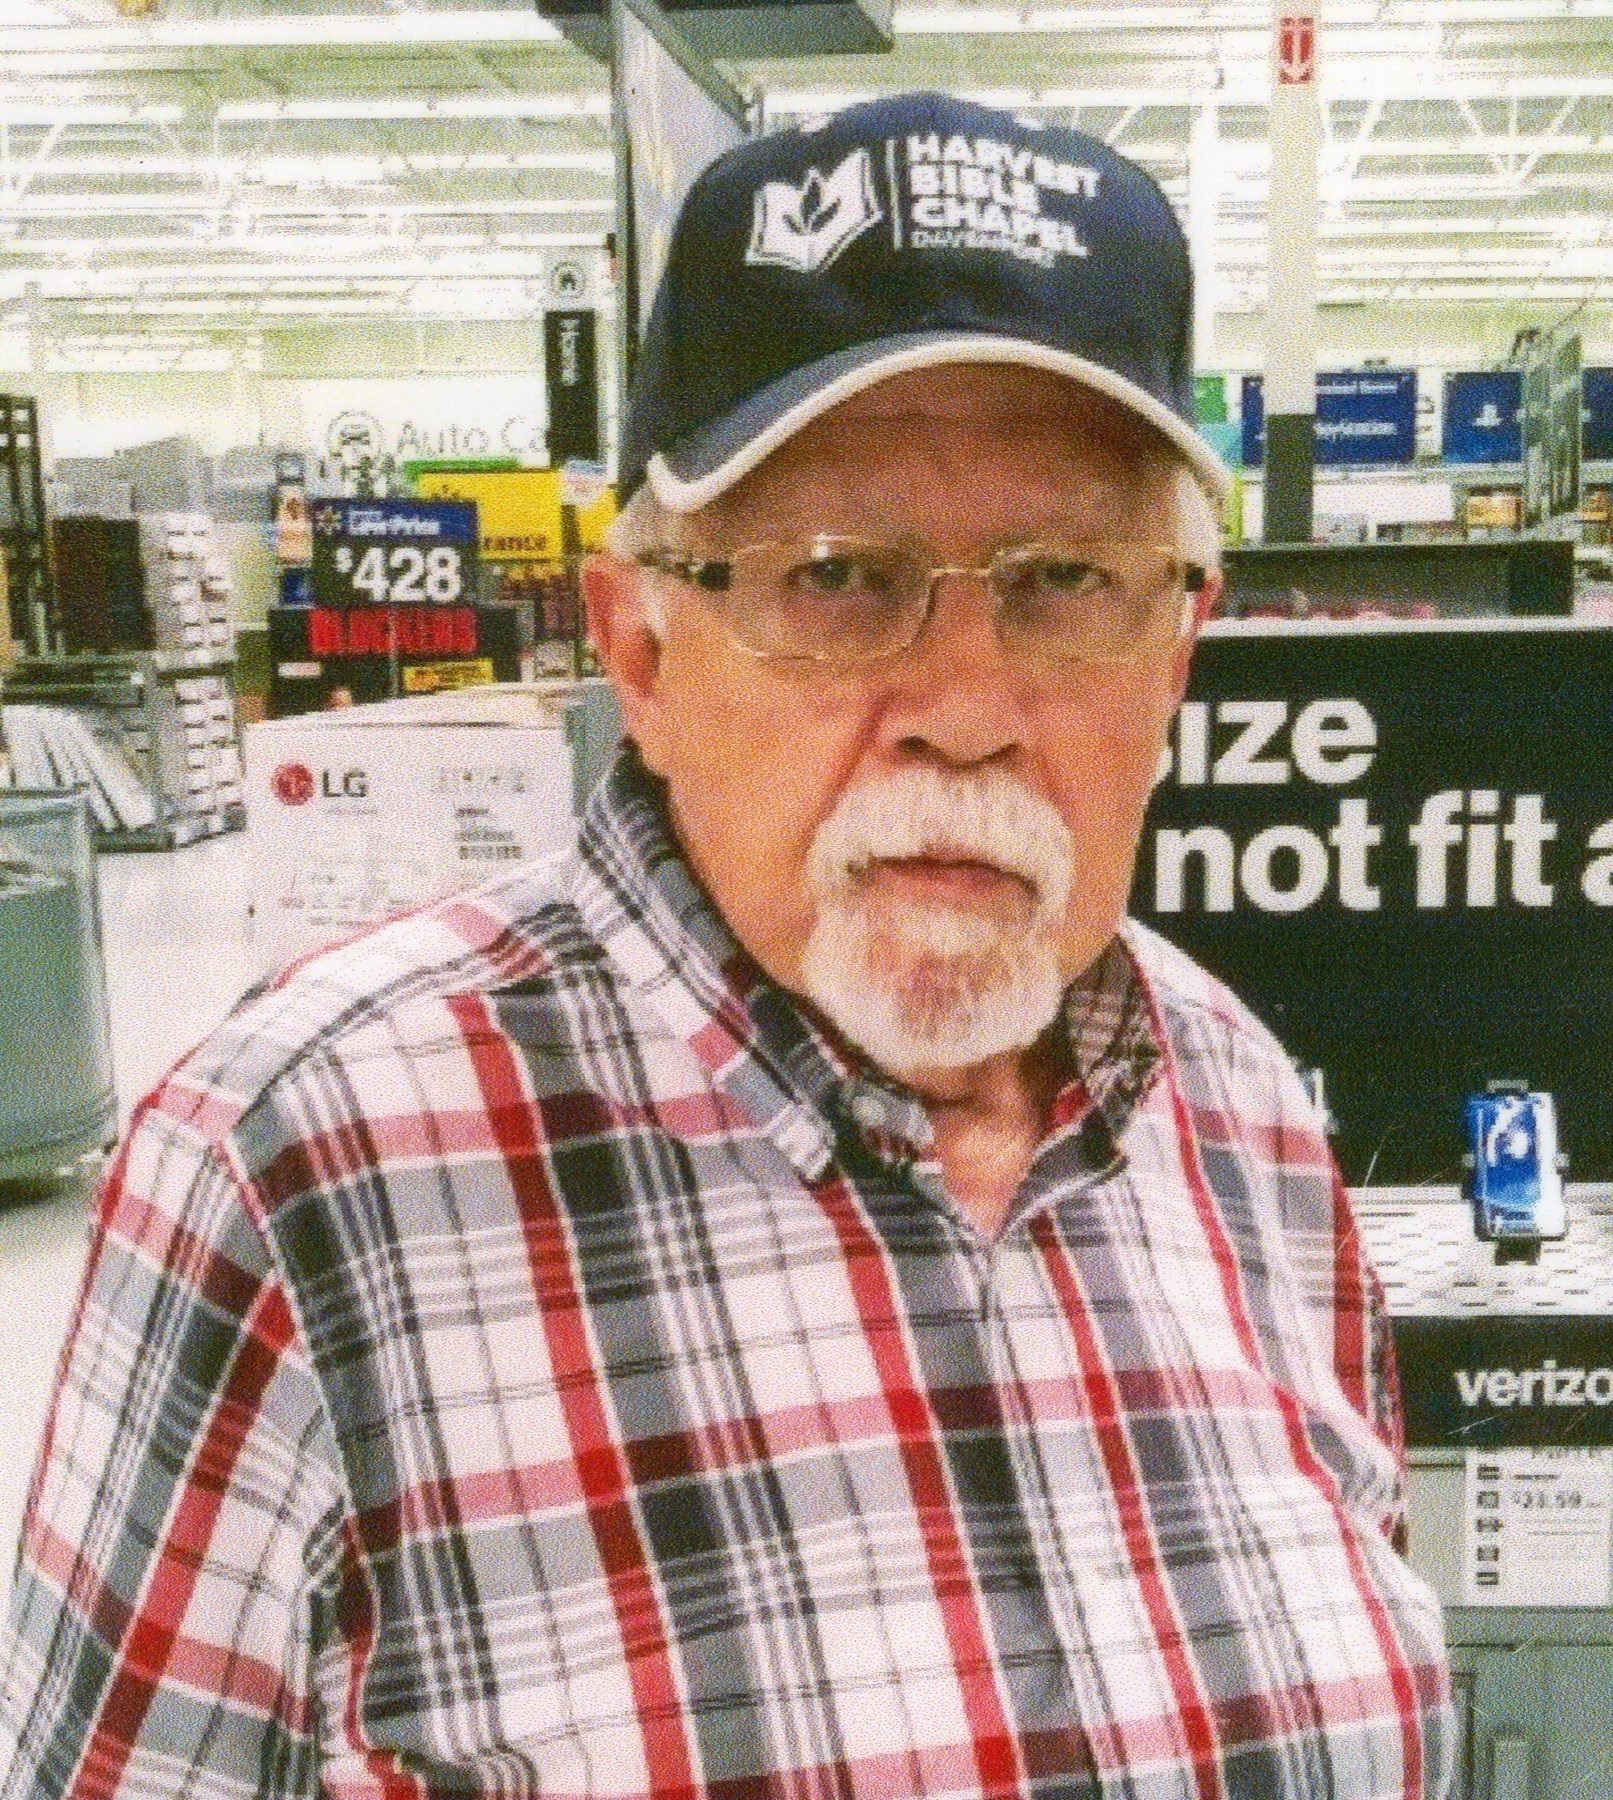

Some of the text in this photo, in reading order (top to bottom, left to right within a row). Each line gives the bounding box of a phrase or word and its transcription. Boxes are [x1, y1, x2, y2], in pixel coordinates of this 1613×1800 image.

[910, 164, 1040, 213] BIBLE
[911, 198, 1088, 259] CHAPEL
[398, 415, 547, 453] Auto Ca
[484, 535, 547, 551] rance
[1156, 699, 1377, 784] ize
[322, 768, 367, 798] LG
[1156, 798, 1382, 912] not
[1409, 789, 1557, 908] fit
[1455, 1359, 1613, 1407] verizo
